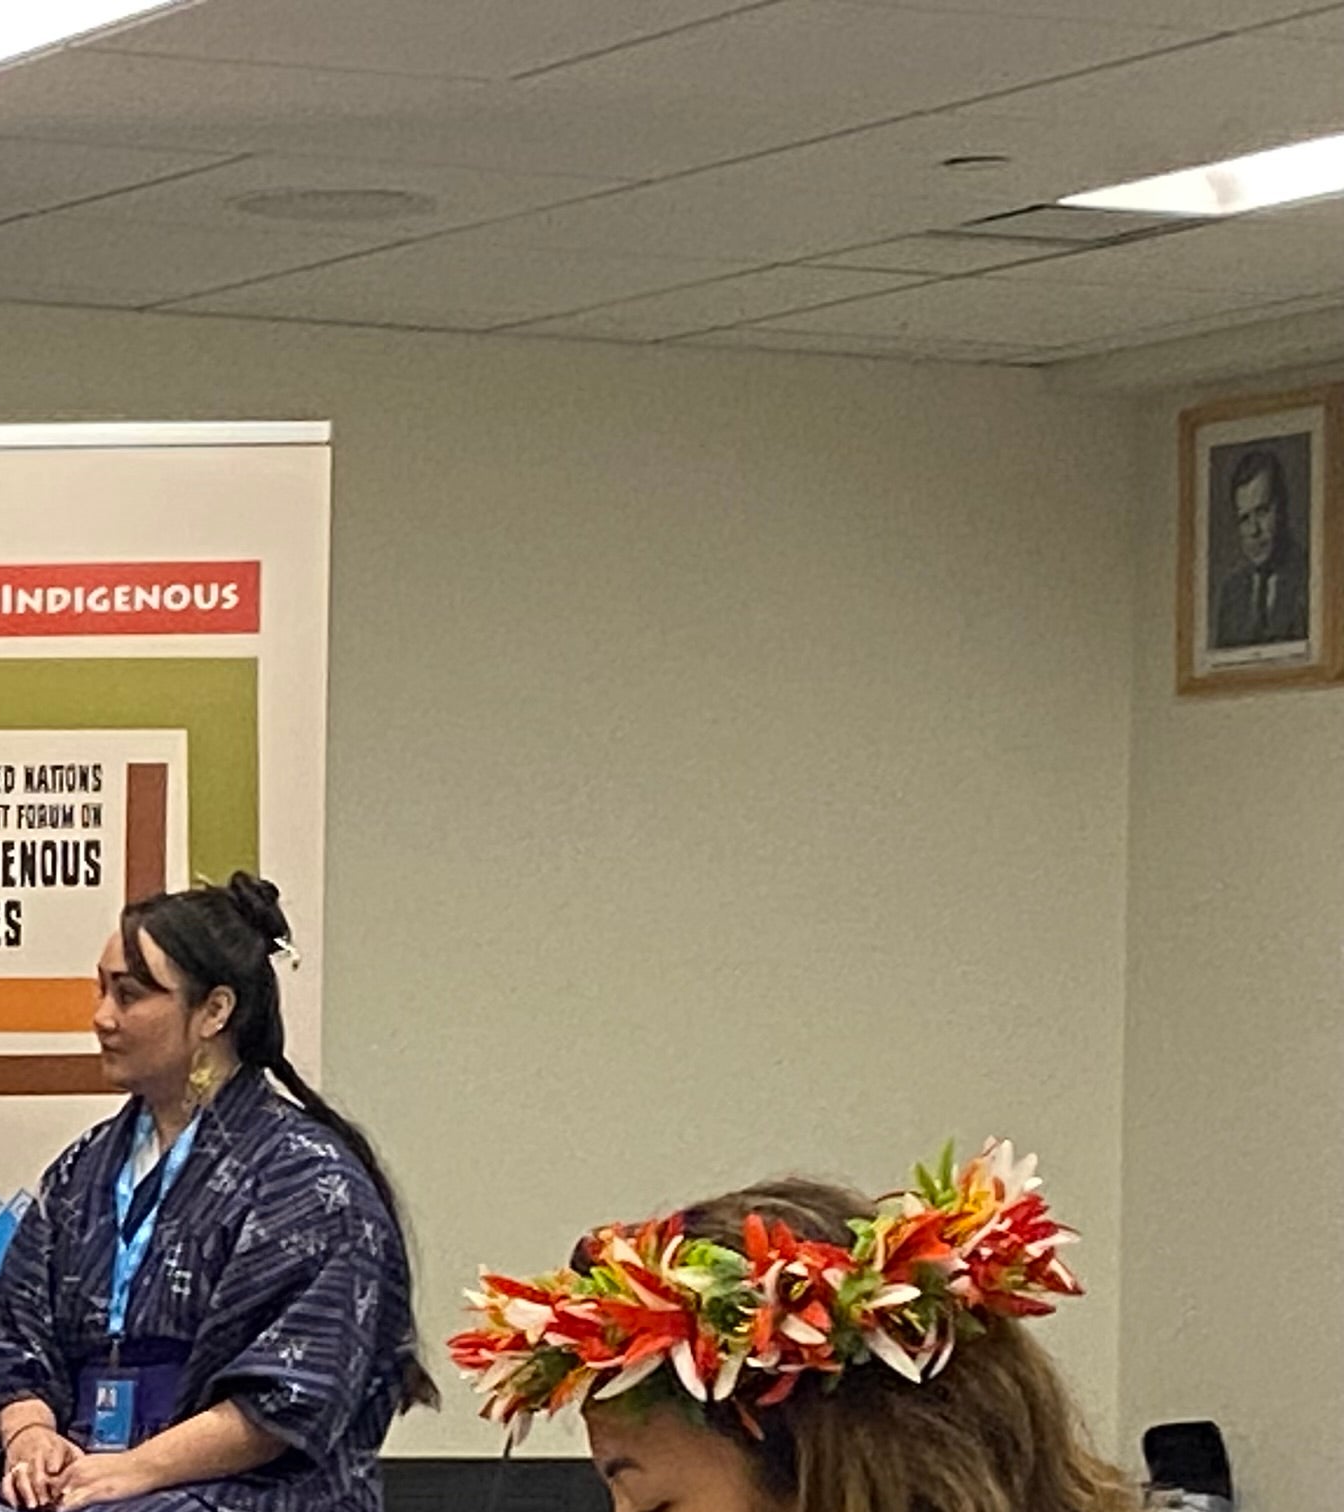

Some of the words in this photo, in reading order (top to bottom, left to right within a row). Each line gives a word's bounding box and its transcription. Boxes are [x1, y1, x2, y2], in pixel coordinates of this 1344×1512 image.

[23, 764, 103, 794] NATIONS
[16, 804, 75, 830] FORUM
[81, 803, 103, 829] ON
